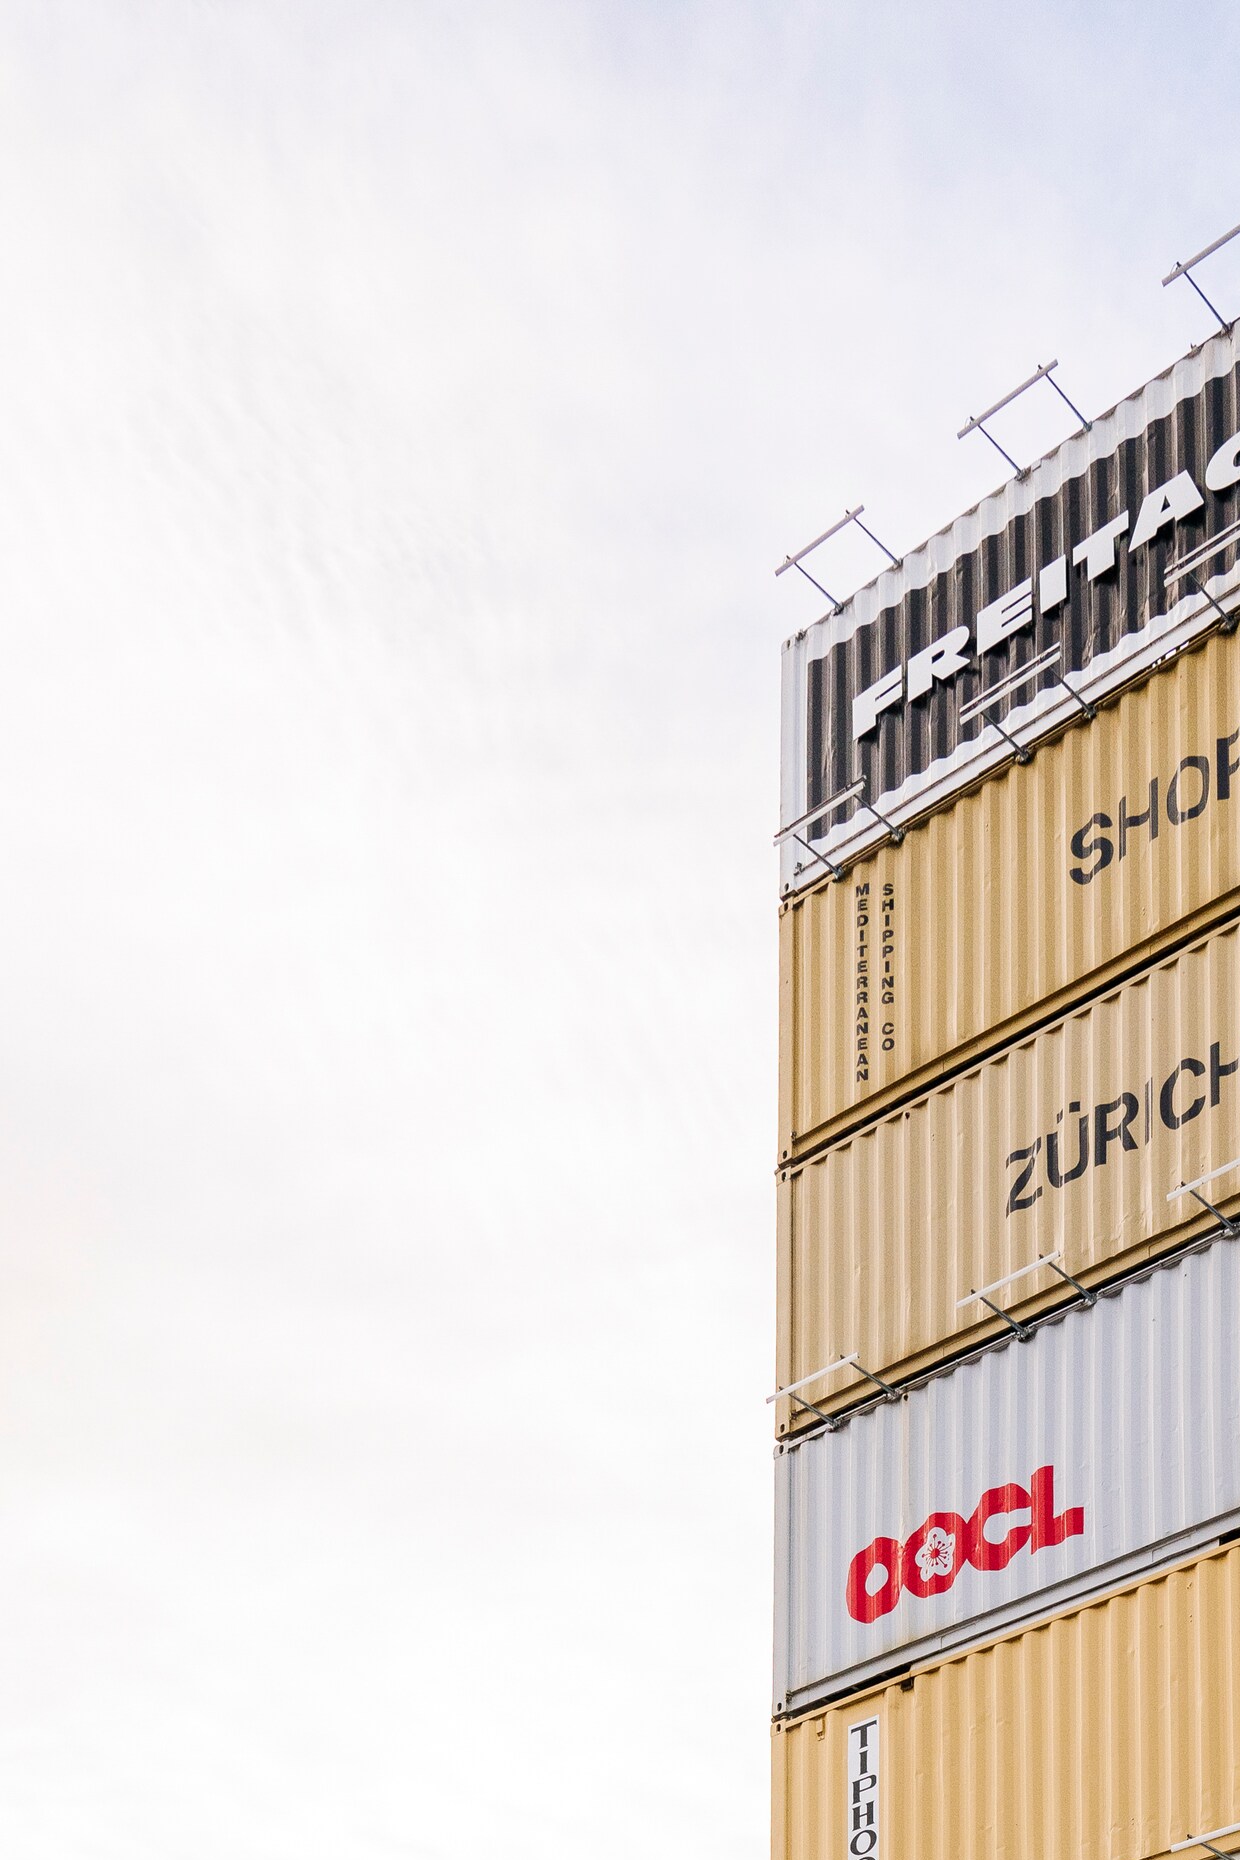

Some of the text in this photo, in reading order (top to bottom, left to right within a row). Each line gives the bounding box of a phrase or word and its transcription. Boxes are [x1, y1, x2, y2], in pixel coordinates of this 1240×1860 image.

[856, 882, 870, 1083] MEDITERRANEAN
[881, 883, 895, 1051] SHIPPING CO
[845, 1465, 1084, 1624] OOCL
